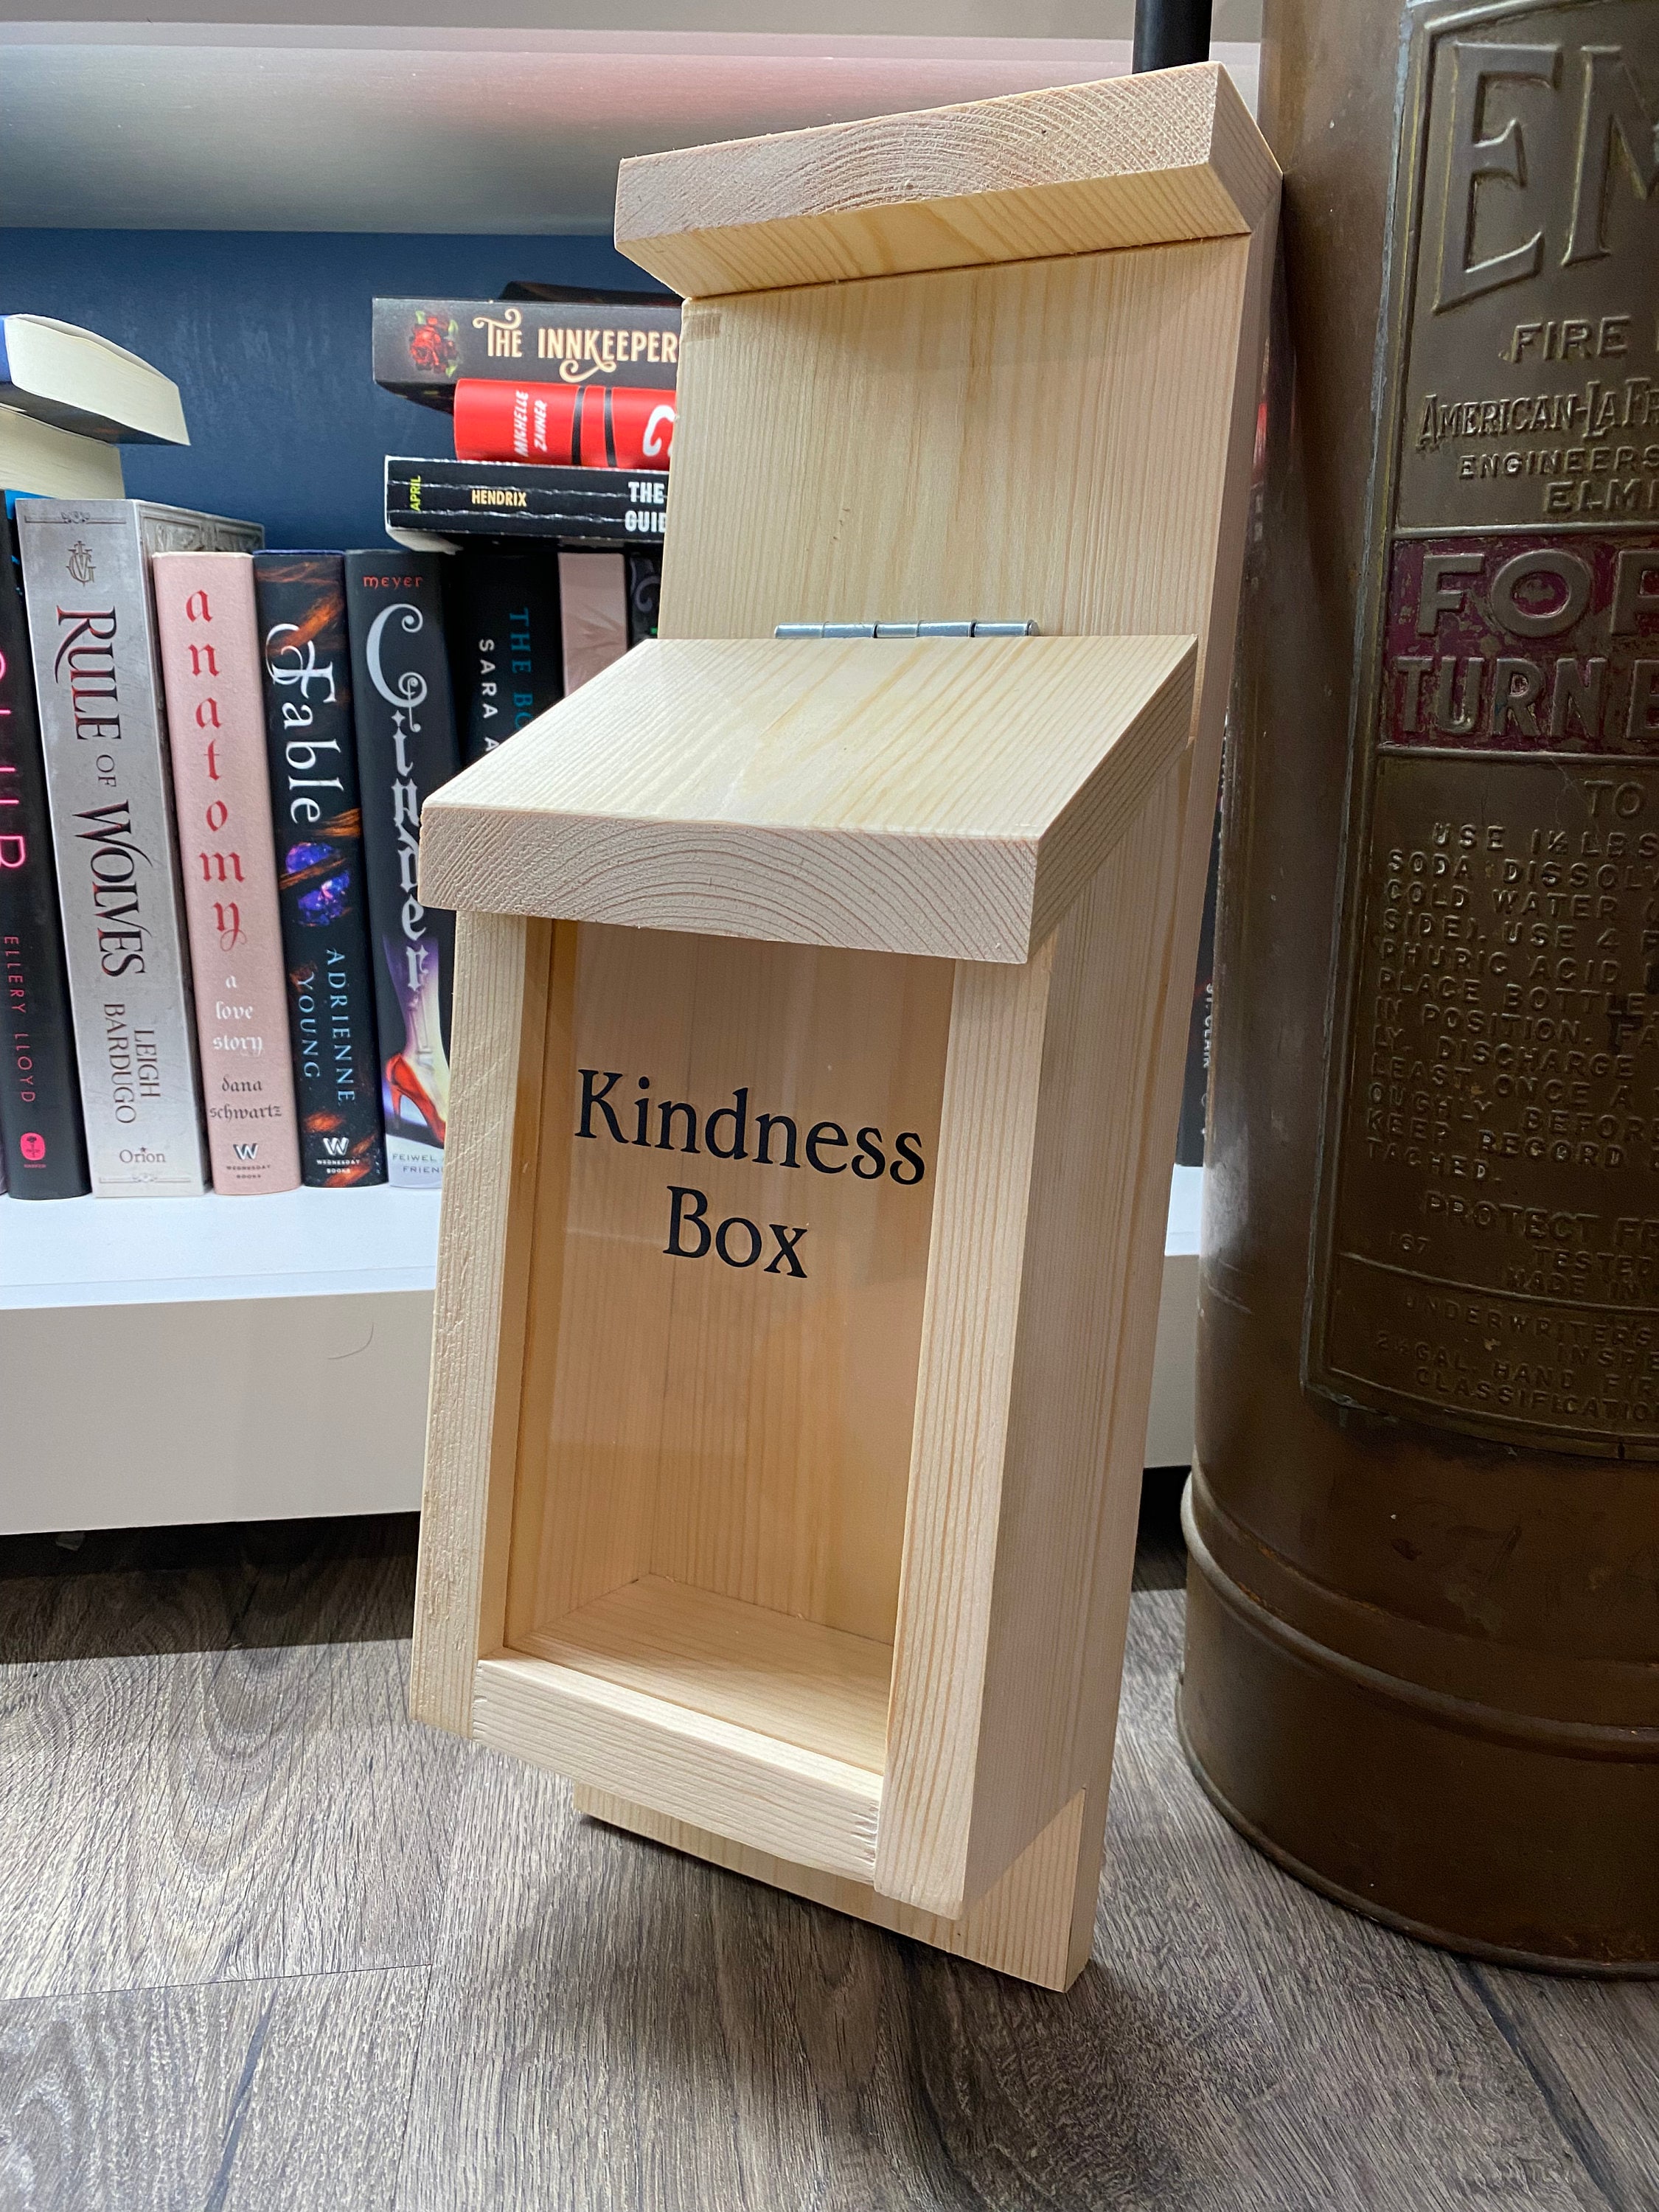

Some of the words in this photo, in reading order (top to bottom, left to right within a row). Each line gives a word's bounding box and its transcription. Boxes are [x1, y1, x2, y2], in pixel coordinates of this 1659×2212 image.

[472, 308, 523, 358] THE
[538, 327, 678, 383] INNKEEPER
[1512, 313, 1631, 364] FIRE
[514, 390, 529, 457] MICHELLE
[410, 475, 421, 512] APRIL
[472, 488, 527, 507] HENDRIX
[628, 481, 665, 504] THE
[363, 576, 423, 590] meyer
[509, 607, 531, 674] THE
[54, 605, 122, 741] RULE
[479, 639, 498, 718] SARA
[265, 623, 344, 824] Fable
[95, 754, 116, 787] OF
[1584, 779, 1647, 818] TO
[1433, 821, 1506, 851] USE
[1388, 848, 1473, 880] SODA
[73, 799, 154, 978] WOLVES
[1385, 878, 1472, 909] COLD
[1492, 888, 1619, 920] WATER
[1502, 922, 1576, 950] USE
[225, 975, 237, 988] a
[1380, 938, 1510, 977] PHURIC
[1528, 955, 1622, 986] ACID
[216, 1001, 254, 1019] love
[1378, 966, 1482, 1005] PLACE
[1503, 982, 1649, 1016] BOTTLE
[2, 936, 26, 1014] ELLERY
[14, 1033, 35, 1102] LLOYD
[295, 972, 321, 1078] YOUNG
[327, 949, 355, 1105] ADRIENNE
[104, 1003, 136, 1124] BARDUGO
[134, 1030, 161, 1099] LEIGH
[212, 1036, 262, 1057] story
[1438, 1034, 1635, 1079] DISCHARGE
[221, 1074, 263, 1092] dana
[1371, 1051, 1474, 1090] LEAST
[1492, 1073, 1591, 1107] ONCE
[209, 1103, 282, 1123] schwartz
[574, 1068, 925, 1186] Kindness
[119, 1147, 166, 1164] Orion
[392, 1152, 437, 1162] FEIWEL
[1368, 1108, 1452, 1141] KEEP
[1477, 1129, 1624, 1169] RECORD
[403, 1166, 443, 1174] FRIEN
[663, 1185, 808, 1279] Box
[1423, 1189, 1601, 1240] PROTECT
